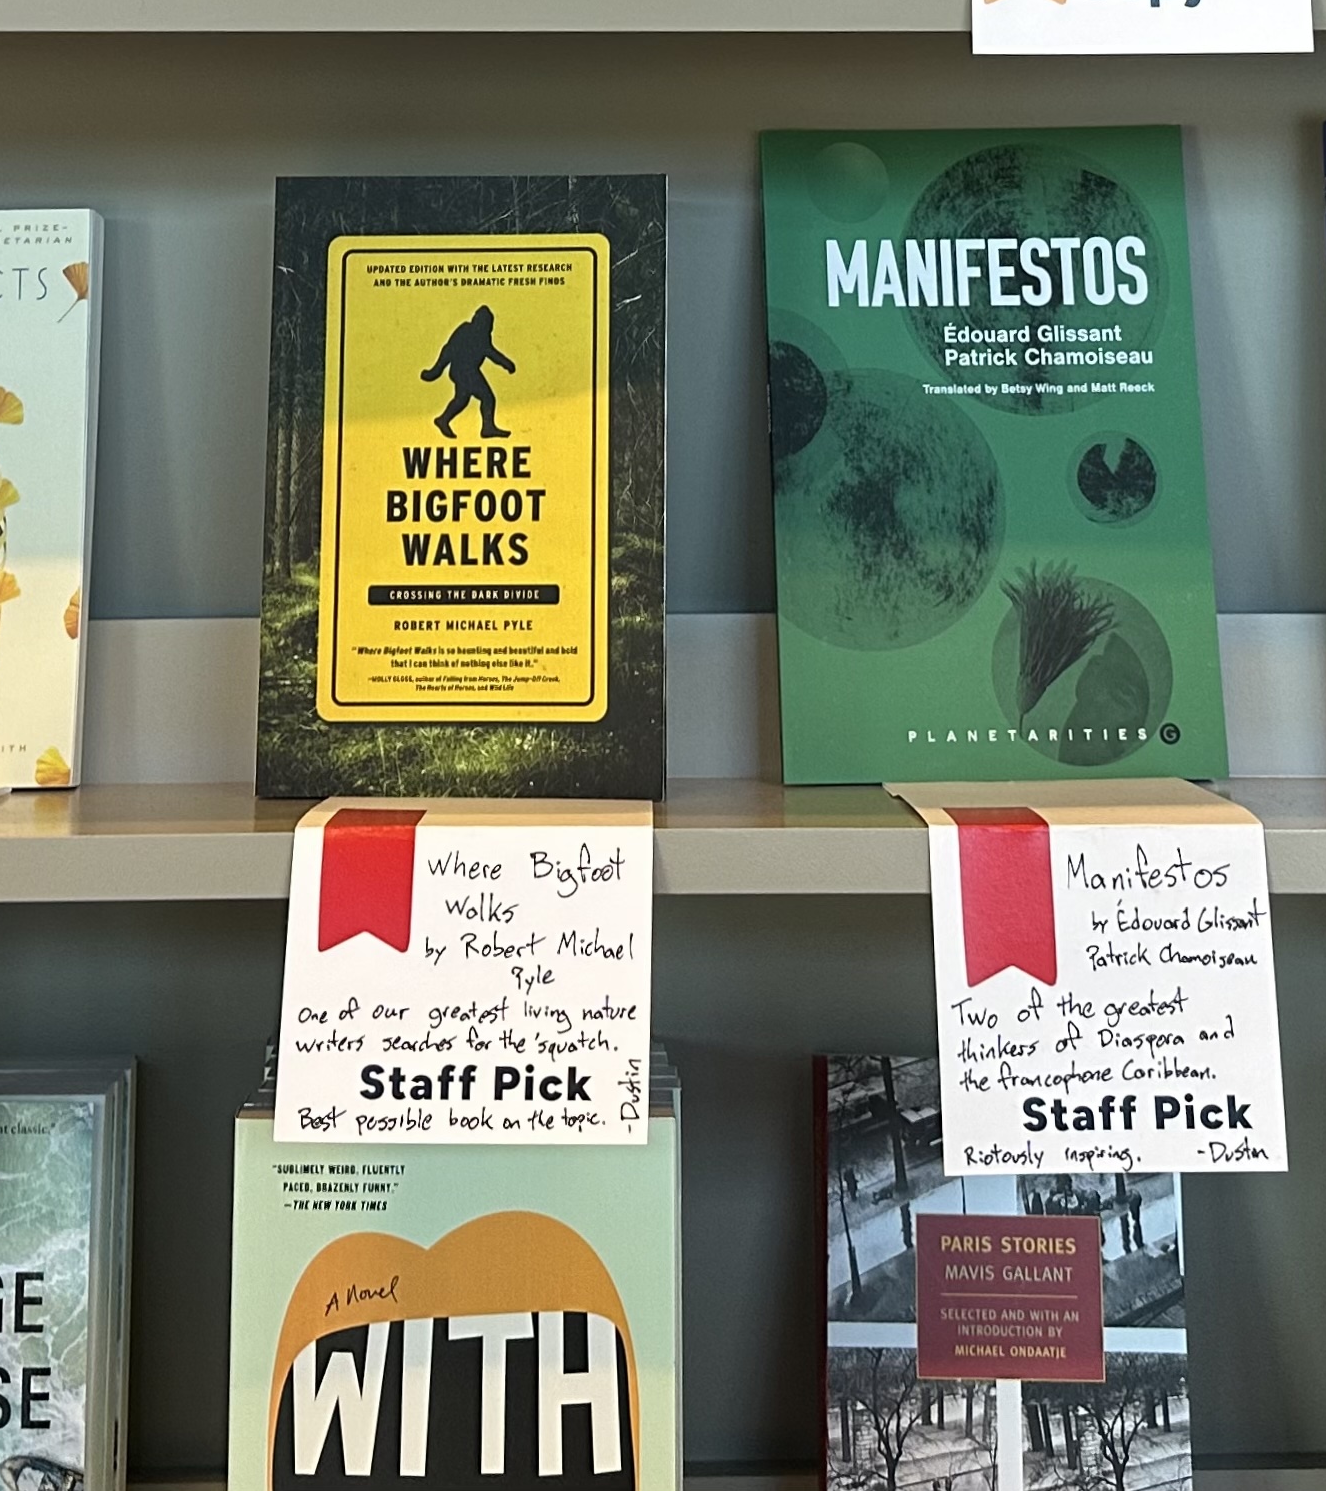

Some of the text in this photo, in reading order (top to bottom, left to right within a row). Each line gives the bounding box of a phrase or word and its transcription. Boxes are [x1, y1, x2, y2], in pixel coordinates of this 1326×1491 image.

[825, 236, 1148, 307] MANIFESTOS
[944, 323, 1122, 344] Édouard Glissant
[945, 348, 1153, 367] Patrick Chamoiseau
[403, 446, 531, 479] WHERE
[386, 489, 546, 523] BIGFOOT
[402, 533, 529, 566] WALKS
[389, 590, 539, 600] CROSSING THE DARK DIVIDE
[394, 620, 533, 631] ROBERT MICHAEL PYLE
[908, 727, 1148, 743] PLANETARITIES
[427, 843, 626, 898] Where Bigfoot
[1067, 843, 1231, 891] Manifestos
[445, 893, 520, 924] Walks
[425, 927, 634, 966] by Robert Michael
[511, 965, 556, 995] Pyle
[360, 1064, 592, 1101] Staff Pick
[1023, 1093, 1253, 1131] Staff Pick
[940, 1236, 1076, 1255] PARIS STORIES
[945, 1265, 1073, 1282] MAVIS GALLANT
[292, 1310, 622, 1477] WITH
